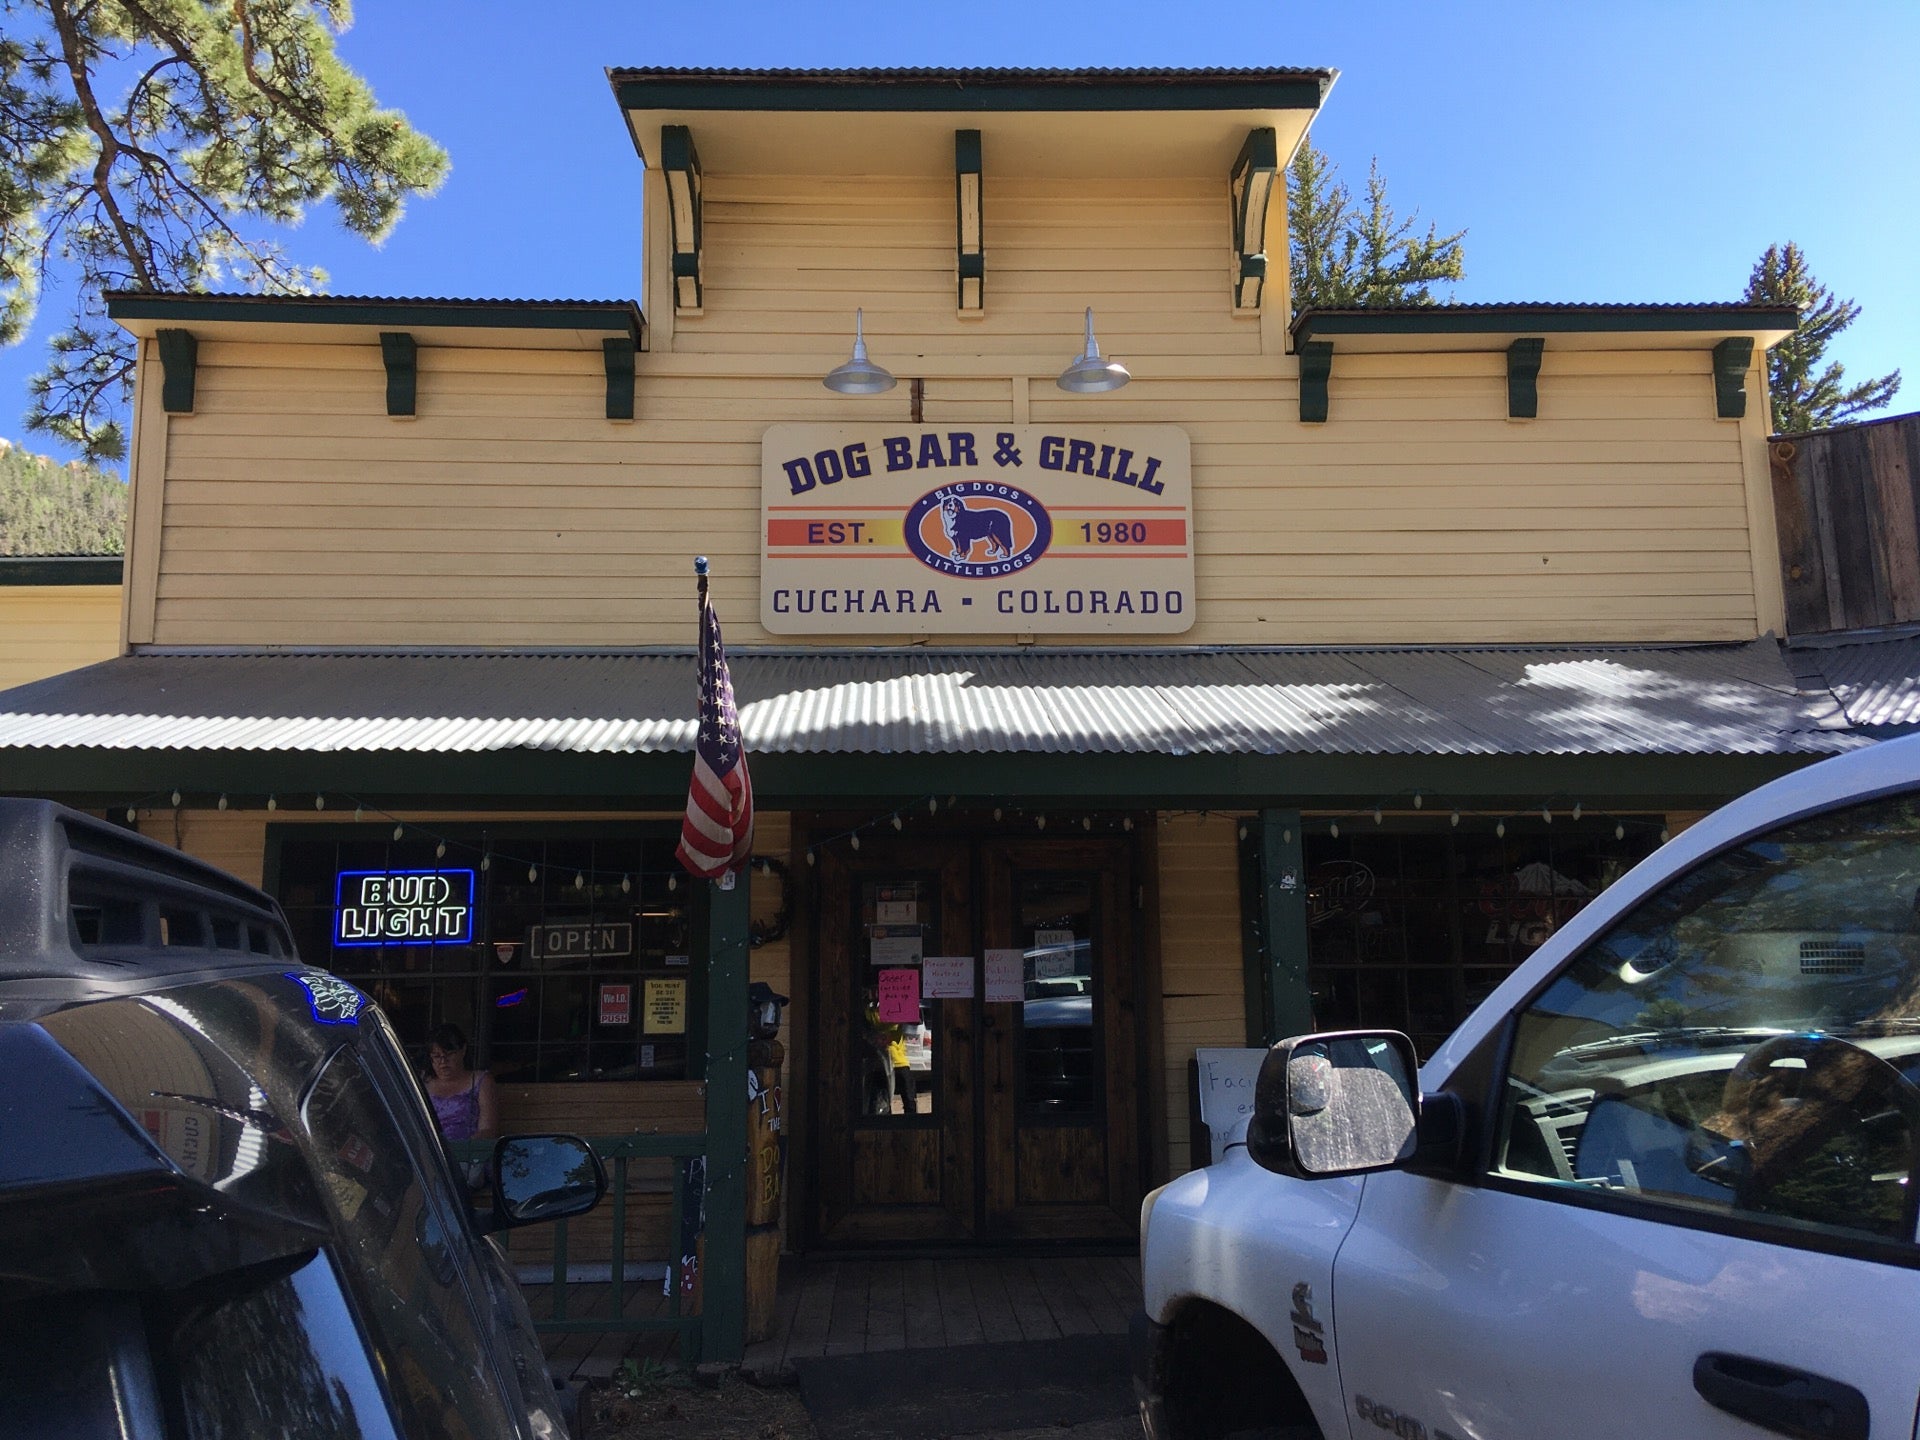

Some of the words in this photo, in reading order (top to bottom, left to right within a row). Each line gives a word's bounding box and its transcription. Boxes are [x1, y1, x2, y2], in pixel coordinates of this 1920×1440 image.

[783, 442, 871, 495] DOG
[883, 432, 978, 472] BAR
[993, 433, 1022, 467] &
[1039, 436, 1165, 496] GRILL
[935, 483, 964, 500] BIG
[973, 483, 1019, 500] DOGS
[808, 522, 873, 544] EST.
[1081, 522, 1146, 543] 1980
[925, 554, 984, 576] LITTLE
[990, 553, 1033, 575] DOGS
[773, 589, 942, 613] CUCHARA
[997, 590, 1182, 614] COLORADO
[361, 876, 449, 906] BUD
[341, 906, 466, 938] LIGHT
[548, 929, 616, 951] OPEN
[601, 1015, 628, 1023] PUSH
